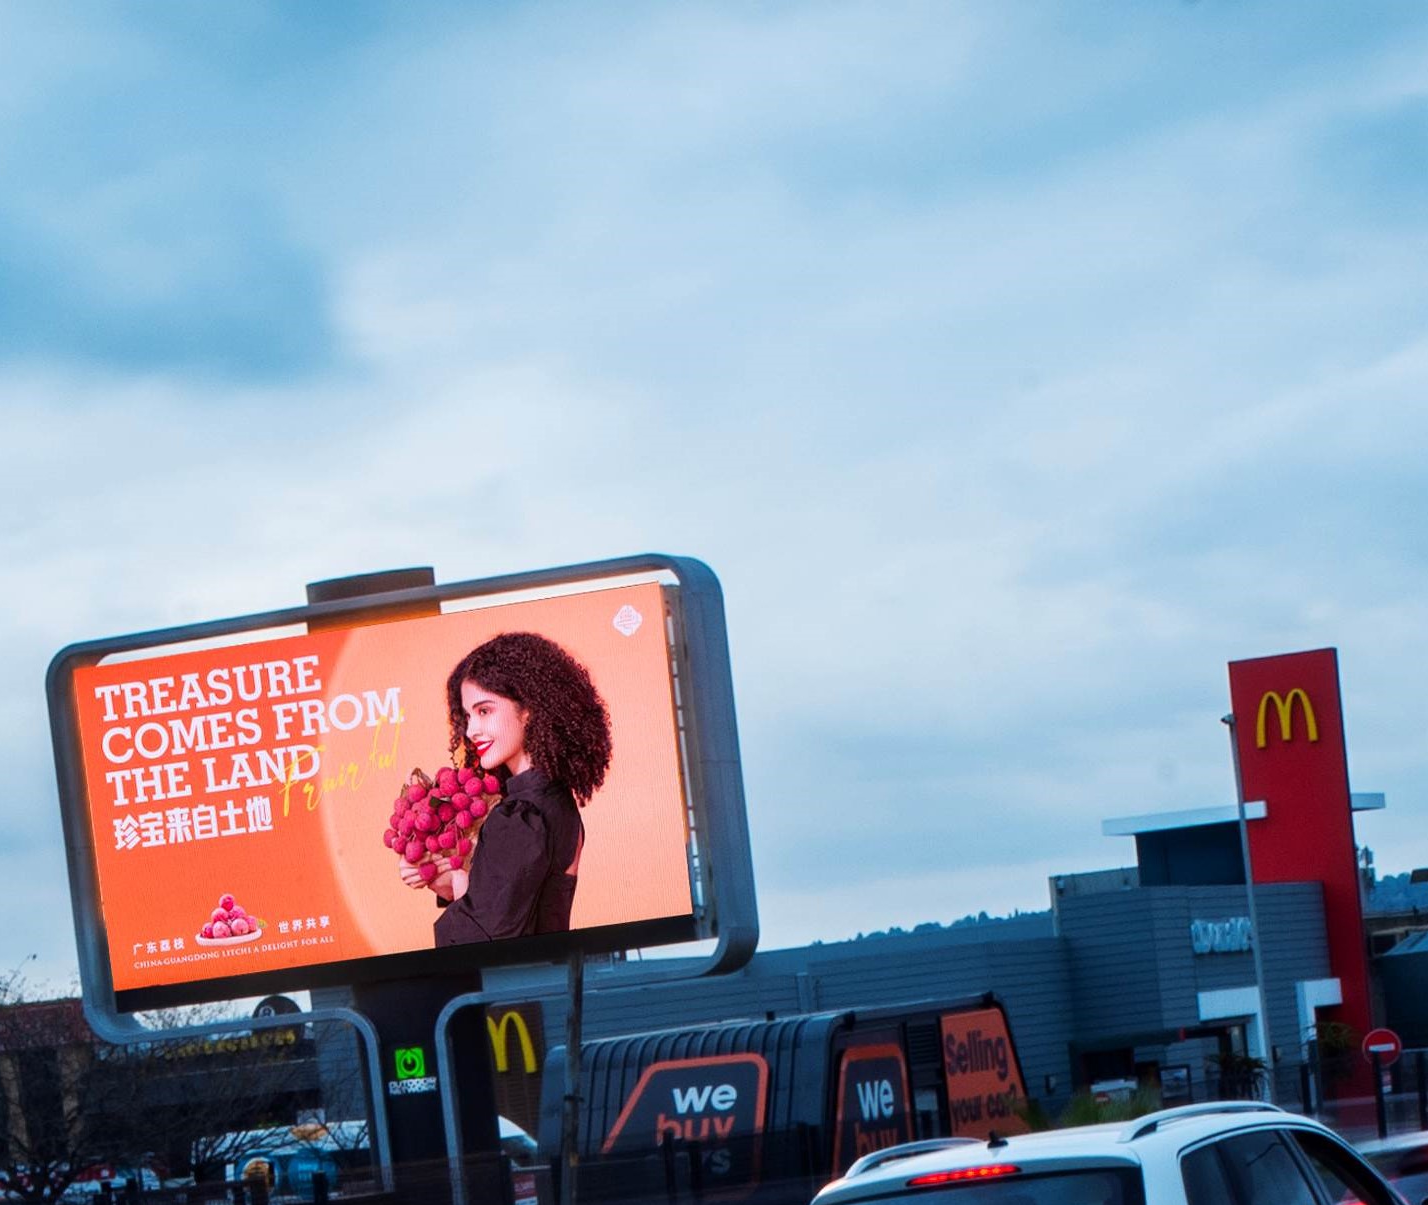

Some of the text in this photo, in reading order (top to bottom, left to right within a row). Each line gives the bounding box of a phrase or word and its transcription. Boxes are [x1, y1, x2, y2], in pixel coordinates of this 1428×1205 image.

[95, 655, 322, 722] TREASURE
[102, 687, 405, 764] COMES FROM
[106, 744, 321, 807] THE LAND
[113, 796, 274, 850] 珍宝来自土地
[262, 940, 298, 952] DELIGHT
[301, 937, 318, 946] FOR
[319, 935, 335, 944] ALL
[945, 1029, 1009, 1081] Selling
[672, 1084, 737, 1114] we
[857, 1079, 894, 1120] we
